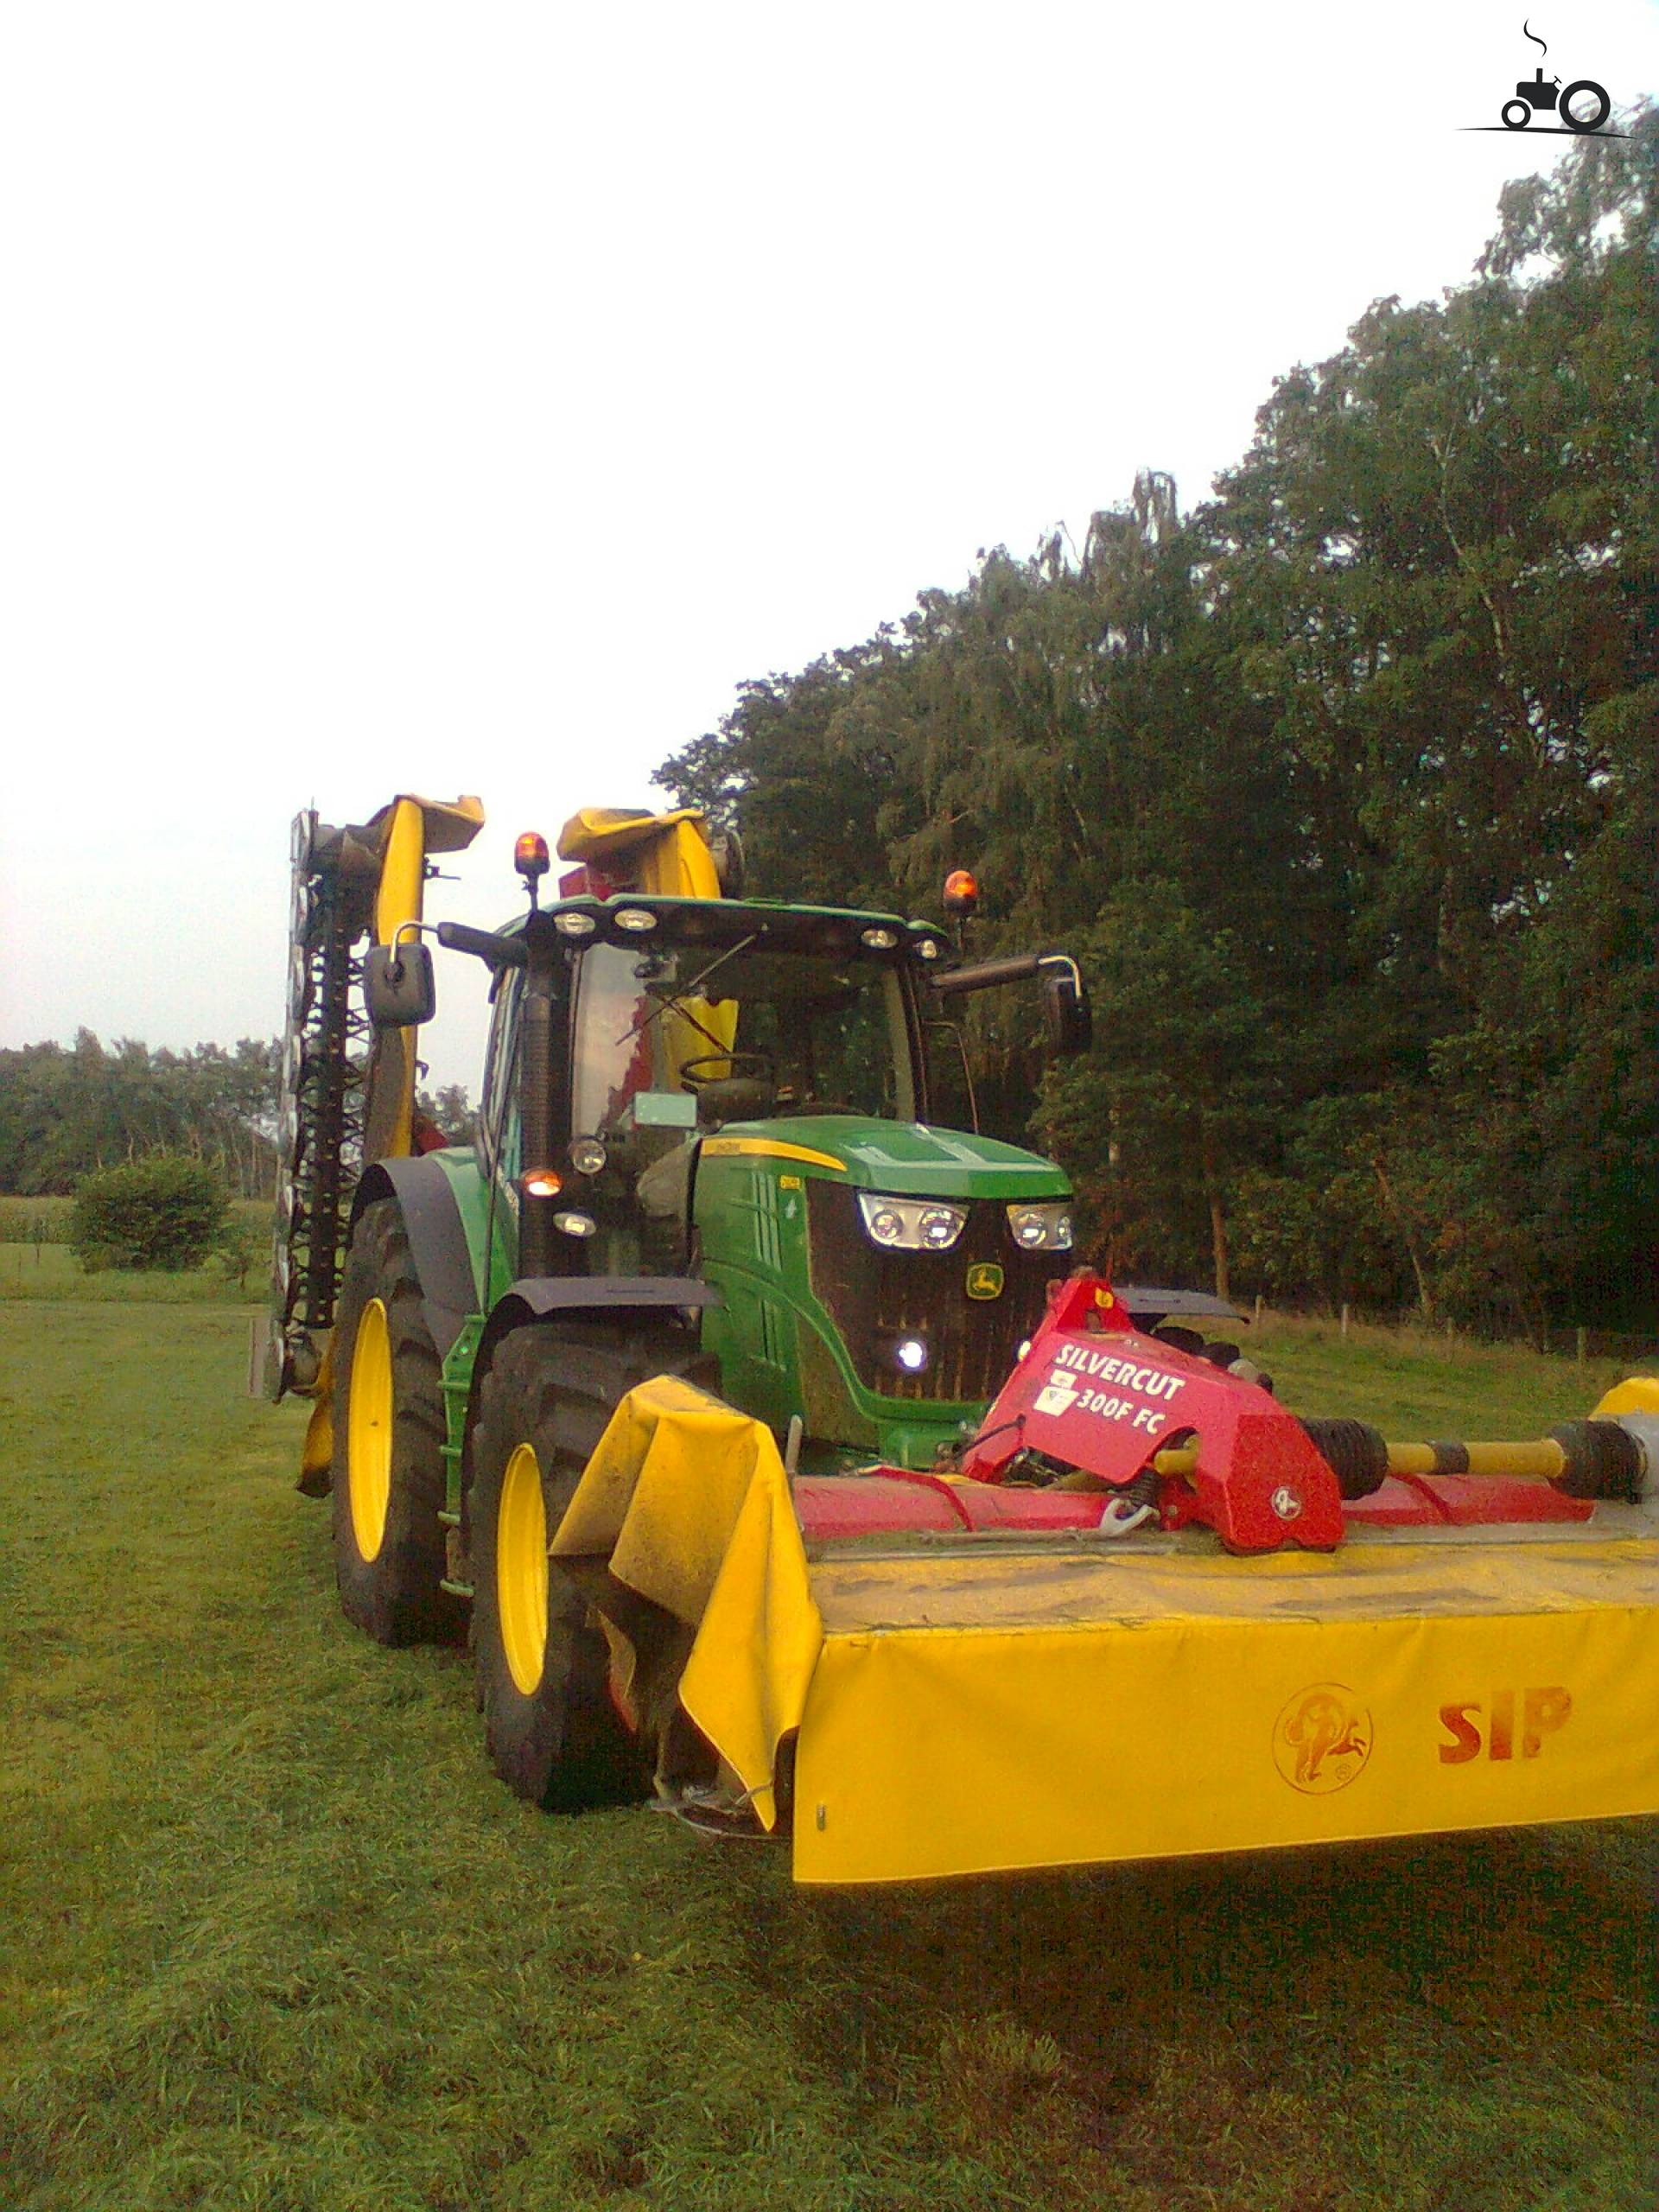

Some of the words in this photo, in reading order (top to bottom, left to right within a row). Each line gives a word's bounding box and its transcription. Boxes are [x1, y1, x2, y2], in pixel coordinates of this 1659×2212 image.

[1054, 1344, 1186, 1401] SILVERCUT
[1076, 1388, 1134, 1421] 300F
[1132, 1408, 1166, 1435] FC
[1438, 1687, 1572, 1764] SIP
